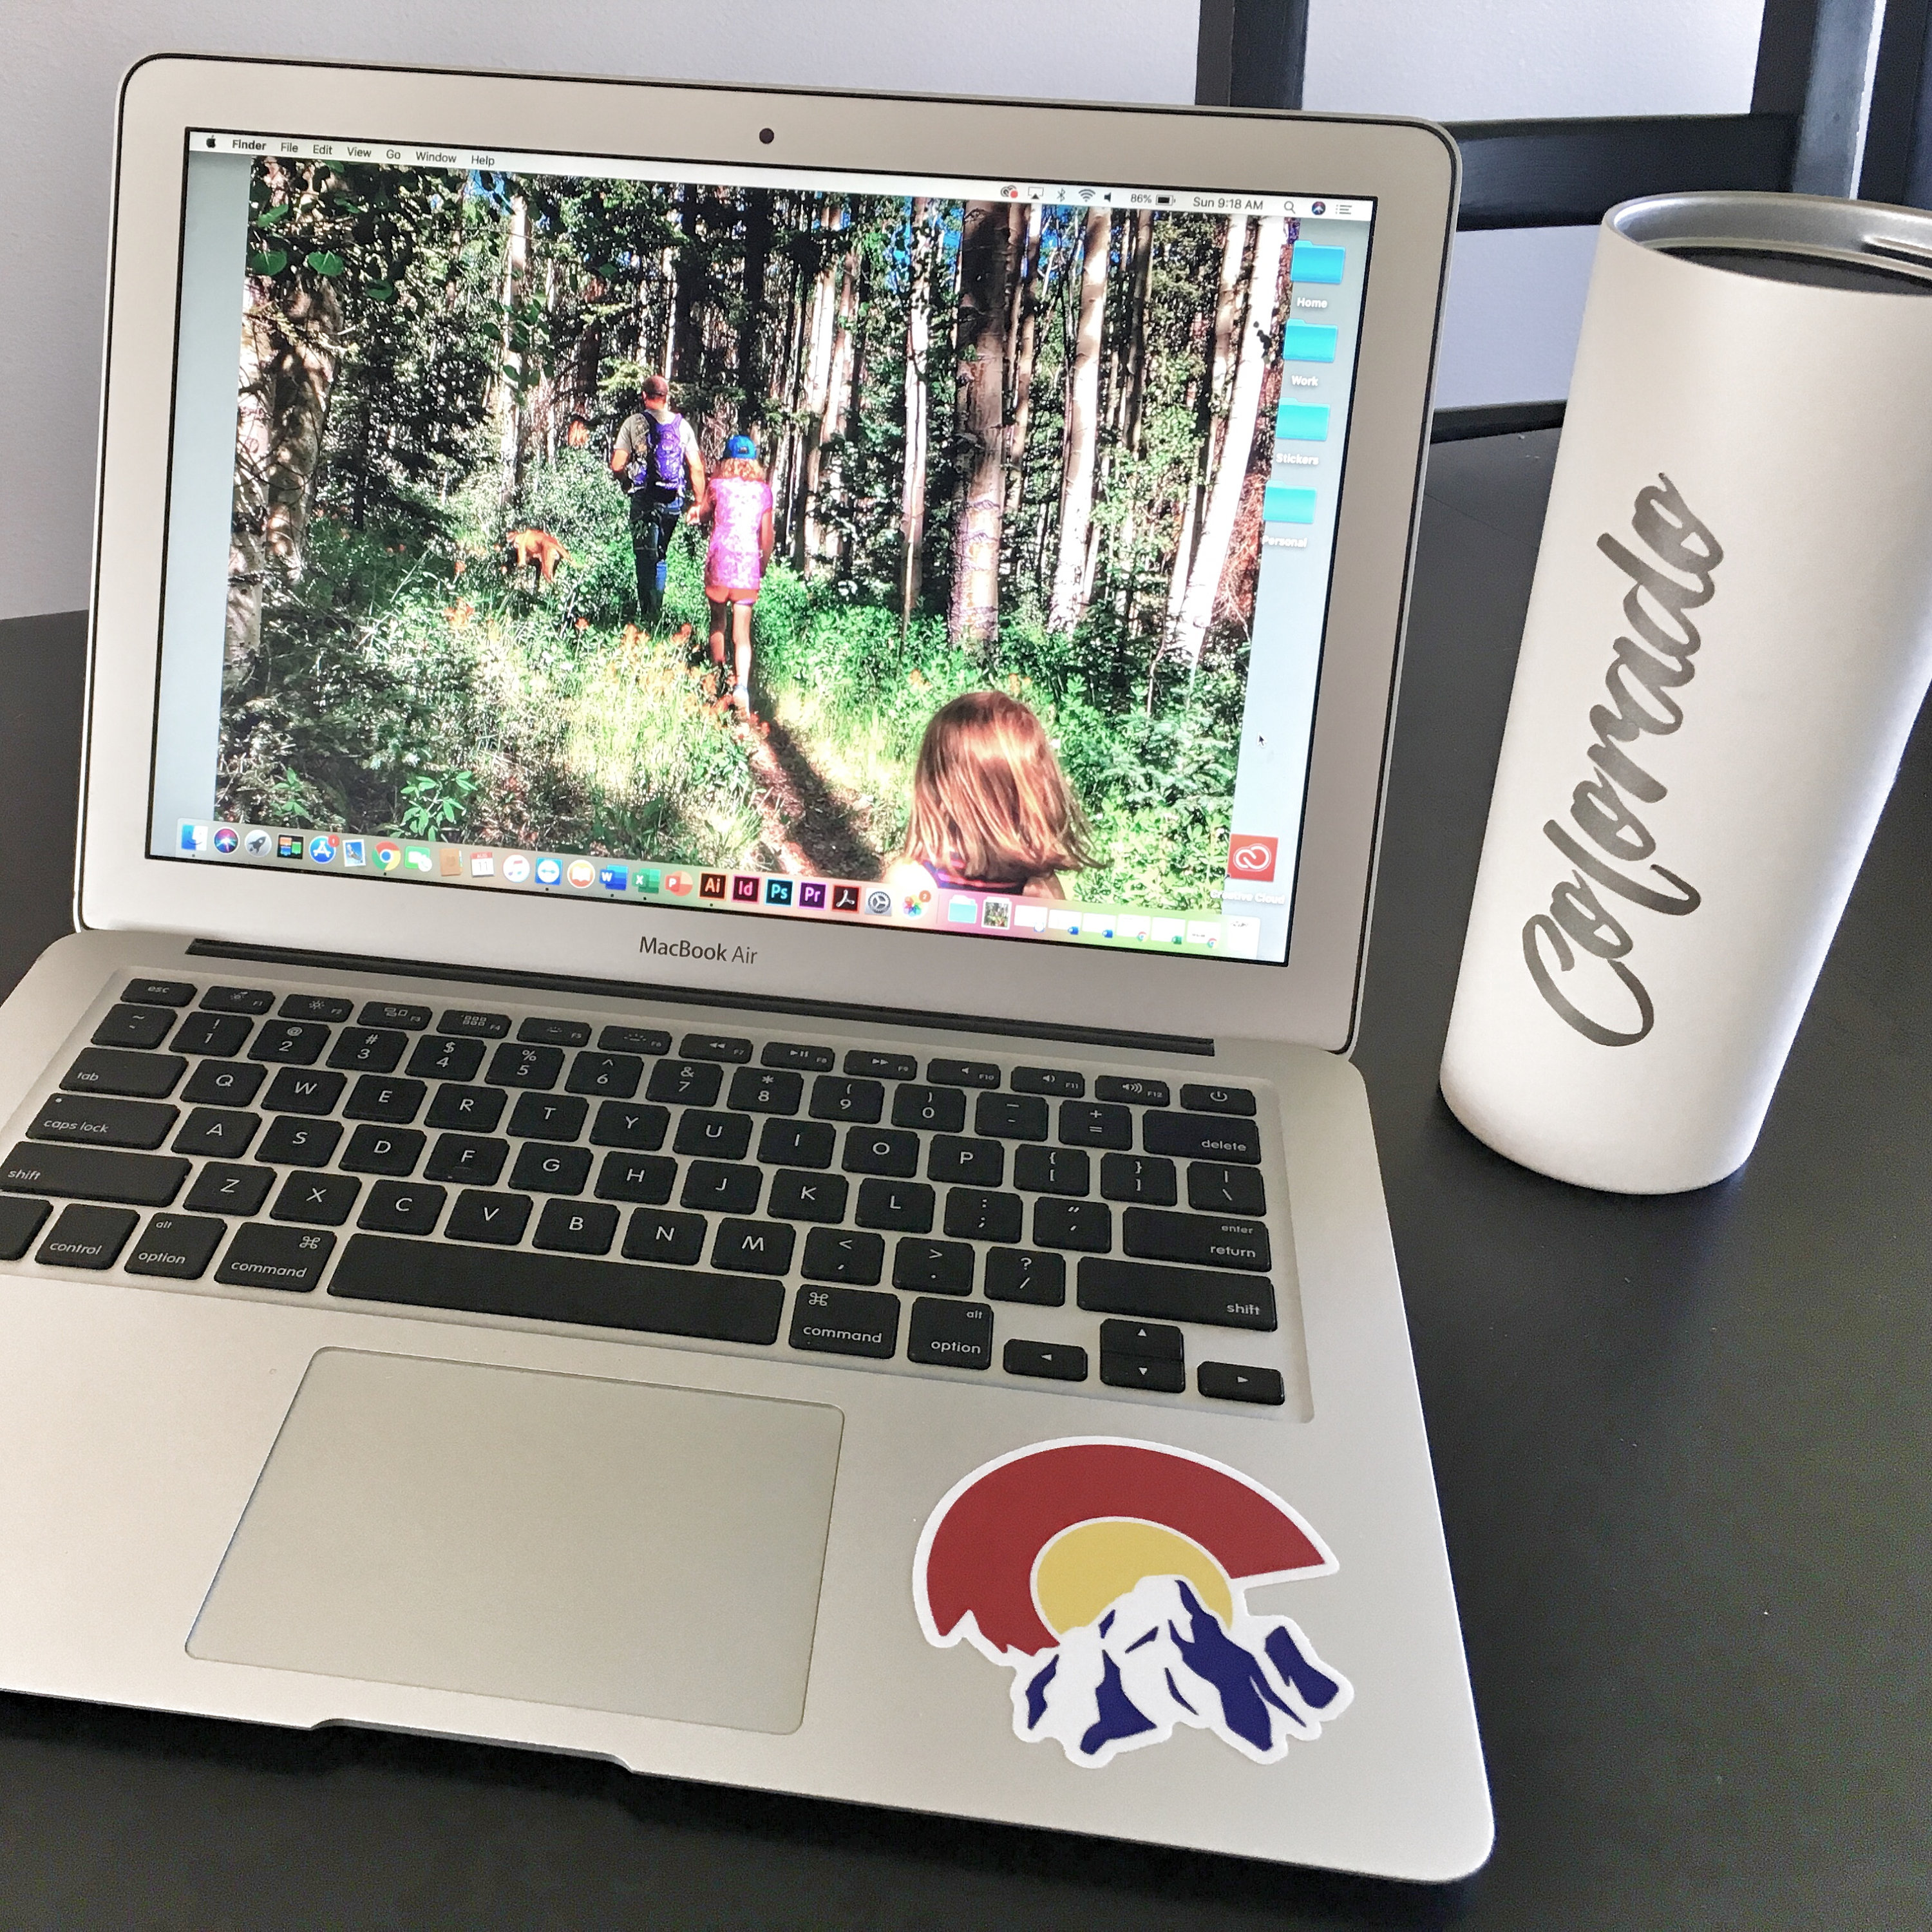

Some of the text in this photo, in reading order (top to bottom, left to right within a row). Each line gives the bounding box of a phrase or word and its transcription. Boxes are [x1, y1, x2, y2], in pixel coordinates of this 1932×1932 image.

[232, 138, 495, 167] Finder File Edit View Go Window Help
[1130, 193, 1264, 211] 86% Sun 9:18 AM
[1296, 297, 1327, 309] Home
[1291, 375, 1319, 387] Work
[1276, 453, 1319, 466] Stickers
[1262, 535, 1307, 547] Personal
[1523, 472, 1723, 1046] Colorado
[601, 871, 612, 882] W
[636, 875, 643, 885] X
[668, 878, 677, 887] P
[705, 877, 721, 893] Ai
[738, 880, 753, 895] Id
[771, 884, 788, 900] Ps
[804, 887, 820, 902] Pr
[1210, 889, 1285, 905] Creative Cloud
[639, 936, 758, 964] MacBook Air
[213, 1019, 220, 1028] !
[287, 1027, 302, 1036] @
[205, 1034, 213, 1043] 1
[366, 1034, 377, 1044] #
[279, 1041, 292, 1051] 2
[444, 1042, 455, 1053] $
[357, 1049, 370, 1059] 3
[522, 1050, 536, 1061] %
[437, 1057, 449, 1067] 4
[517, 1065, 529, 1075] 5
[681, 1067, 694, 1077] &
[77, 1072, 99, 1081] tab
[216, 1075, 233, 1086] Q
[597, 1074, 607, 1084] 6
[296, 1082, 317, 1094] W
[679, 1081, 690, 1092] 7
[847, 1084, 851, 1094] (
[379, 1091, 392, 1103] E
[758, 1091, 769, 1101] 8
[928, 1092, 932, 1102] )
[460, 1099, 473, 1111] R
[840, 1099, 851, 1109] 9
[545, 1107, 556, 1119] T
[44, 1121, 109, 1134] caps lock
[626, 1116, 638, 1128] Y
[206, 1124, 224, 1137] A
[706, 1125, 723, 1137] U
[293, 1132, 307, 1144] S
[795, 1134, 800, 1146] I
[374, 1141, 391, 1153] D
[873, 1142, 889, 1155] O
[1202, 1140, 1246, 1151] delete
[461, 1150, 475, 1162] F
[960, 1152, 973, 1164] P
[543, 1159, 560, 1171] G
[8, 1170, 41, 1180] shift
[627, 1169, 644, 1182] H
[221, 1179, 240, 1192] Z
[715, 1179, 726, 1191] J
[307, 1188, 326, 1202] X
[801, 1186, 816, 1200] K
[1223, 1189, 1232, 1200] \
[396, 1198, 412, 1211] C
[890, 1196, 900, 1209] L
[484, 1208, 499, 1220] V
[569, 1217, 583, 1230] B
[656, 1226, 674, 1240] N
[50, 1241, 102, 1255] control
[742, 1236, 763, 1251] M
[839, 1240, 852, 1249] <
[138, 1251, 185, 1265] option
[929, 1249, 942, 1258] >
[1211, 1247, 1255, 1257] return
[231, 1261, 308, 1278] command
[1021, 1258, 1032, 1270] ?
[1020, 1278, 1030, 1289] /
[1227, 1303, 1259, 1314] shift
[967, 1311, 982, 1319] alt
[803, 1325, 882, 1343] command
[931, 1341, 980, 1354] option
